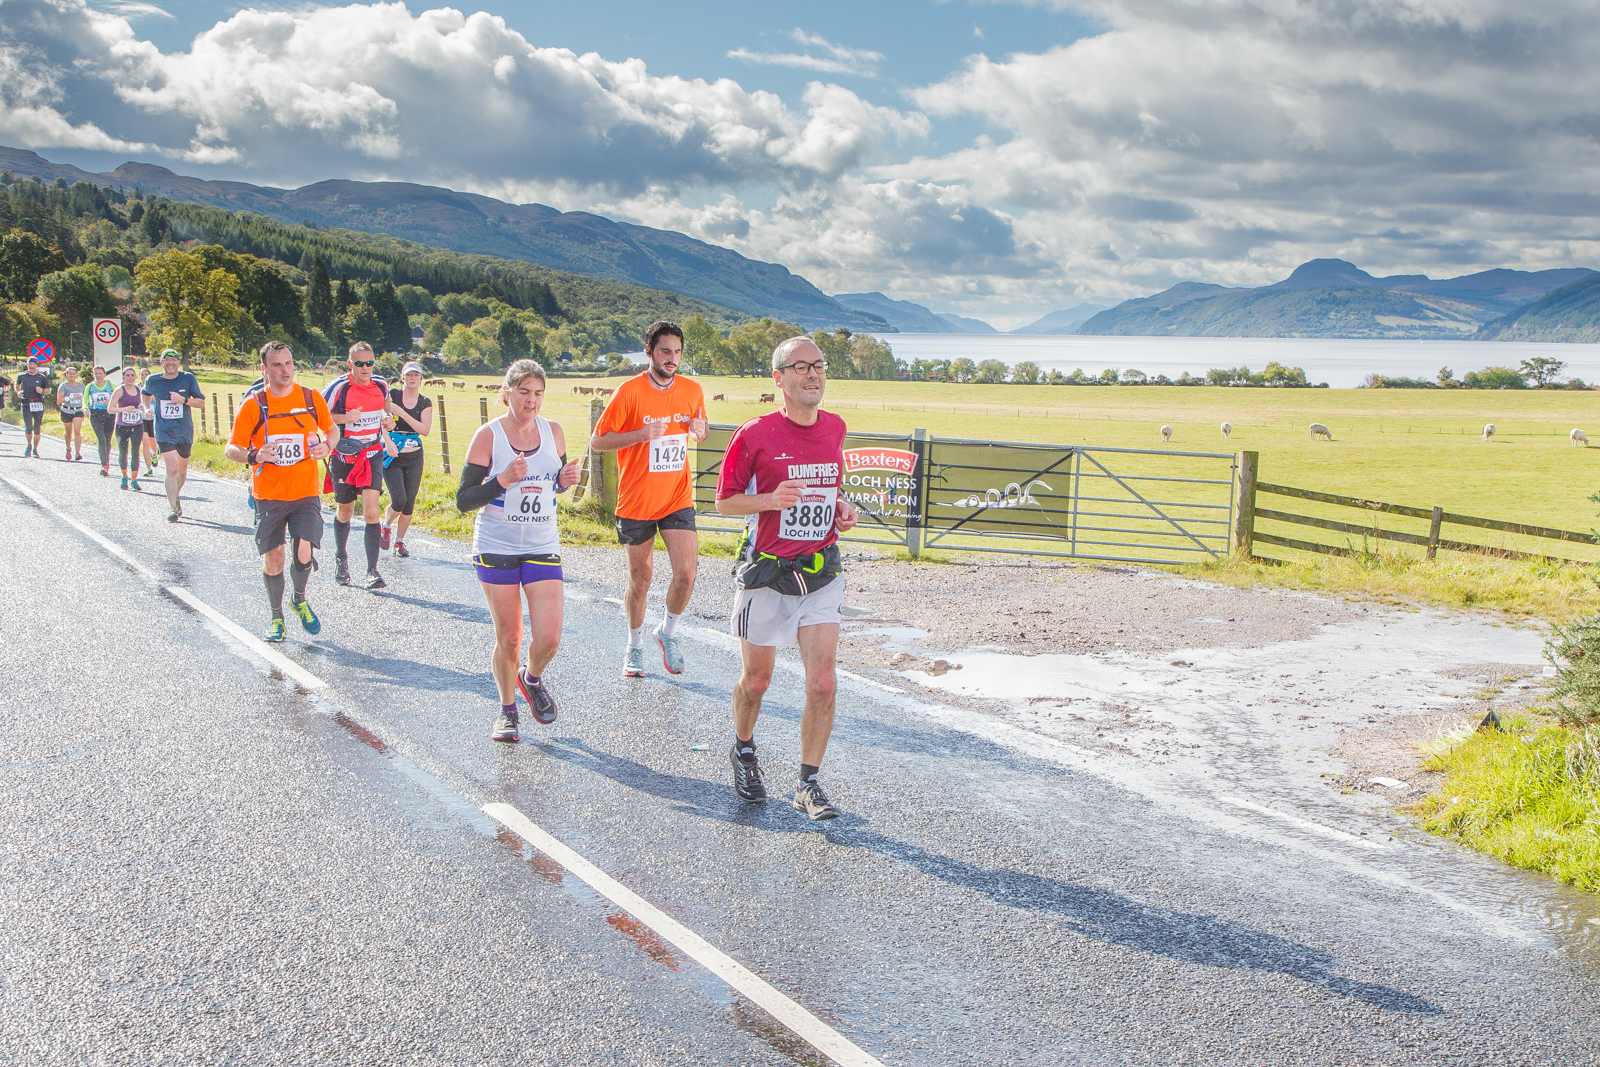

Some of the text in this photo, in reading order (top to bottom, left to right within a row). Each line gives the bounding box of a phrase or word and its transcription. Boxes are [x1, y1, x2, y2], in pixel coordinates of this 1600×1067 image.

[98, 327, 117, 338] 30
[165, 405, 180, 415] 729
[123, 412, 139, 421] 2167
[654, 445, 686, 463] 1426
[672, 462, 685, 470] NES
[848, 452, 911, 470] Baxters
[787, 463, 839, 479] DUMFRIES
[822, 477, 837, 485] CLUB
[842, 474, 917, 490] LOCH NESS
[801, 495, 825, 503] Baxters
[843, 489, 918, 507] MARATHON
[520, 495, 542, 514] 66
[507, 514, 551, 523] LOCH NESS
[784, 504, 832, 527] 3880
[884, 509, 894, 519] of
[893, 509, 922, 521] Running
[784, 528, 828, 538] LOCH NES
